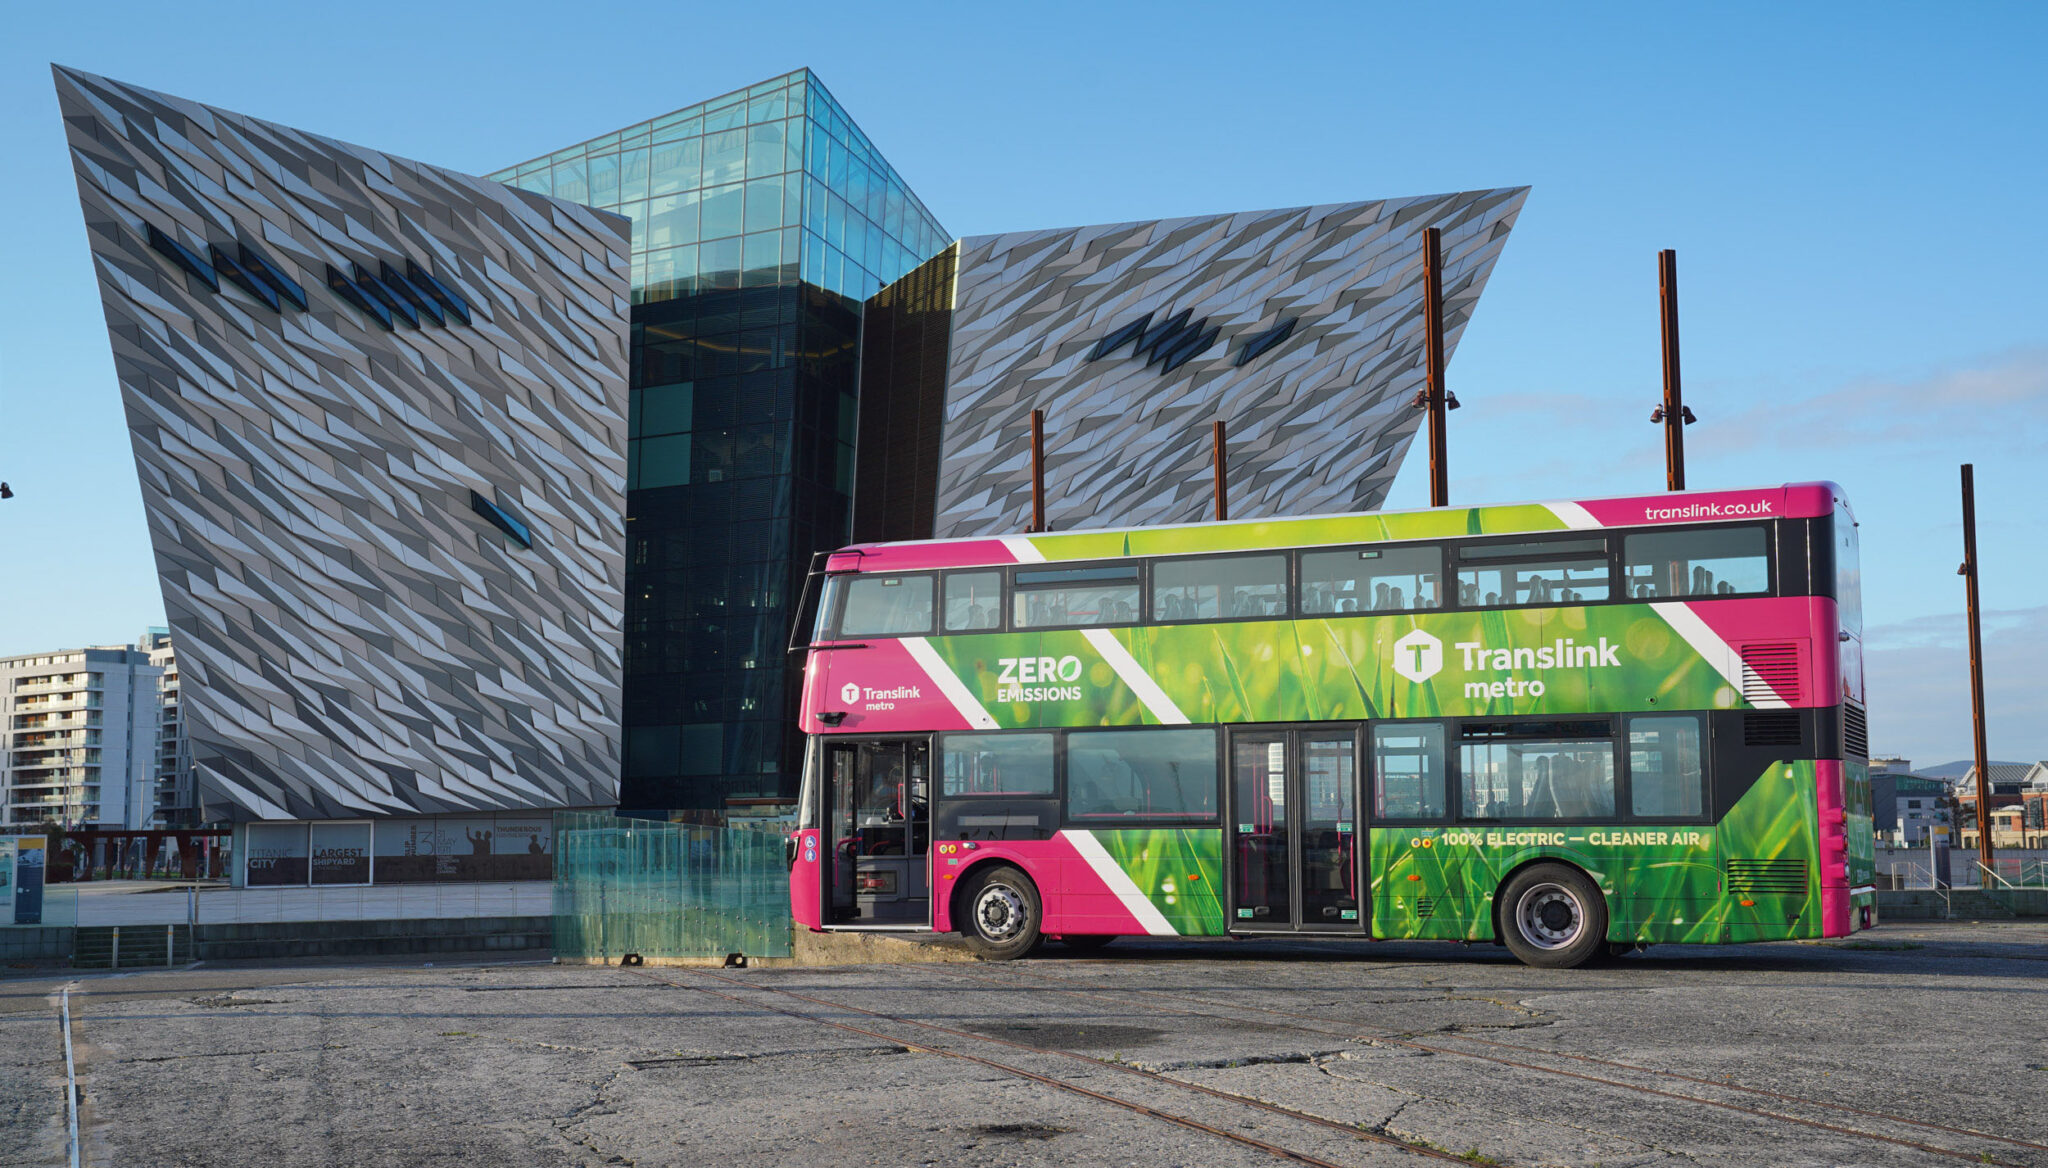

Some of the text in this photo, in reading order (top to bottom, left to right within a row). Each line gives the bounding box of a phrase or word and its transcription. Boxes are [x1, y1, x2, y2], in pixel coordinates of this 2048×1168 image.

[1645, 499, 1773, 520] translink.co.uk
[1455, 637, 1622, 671] Translink
[997, 655, 1082, 684] ZERO
[863, 685, 920, 700] Translink
[997, 686, 1082, 703] EMISSIONS
[1464, 677, 1545, 698] metro
[865, 702, 895, 711] metro
[418, 831, 434, 856] 3
[1441, 832, 1484, 846] 100%
[1487, 832, 1565, 846] ELECTRIC
[1589, 832, 1668, 846] CLEANER
[1671, 832, 1700, 846] AIR
[313, 848, 364, 858] LARGEST
[249, 859, 277, 869] CITY
[312, 858, 356, 866] SHIPYARD
